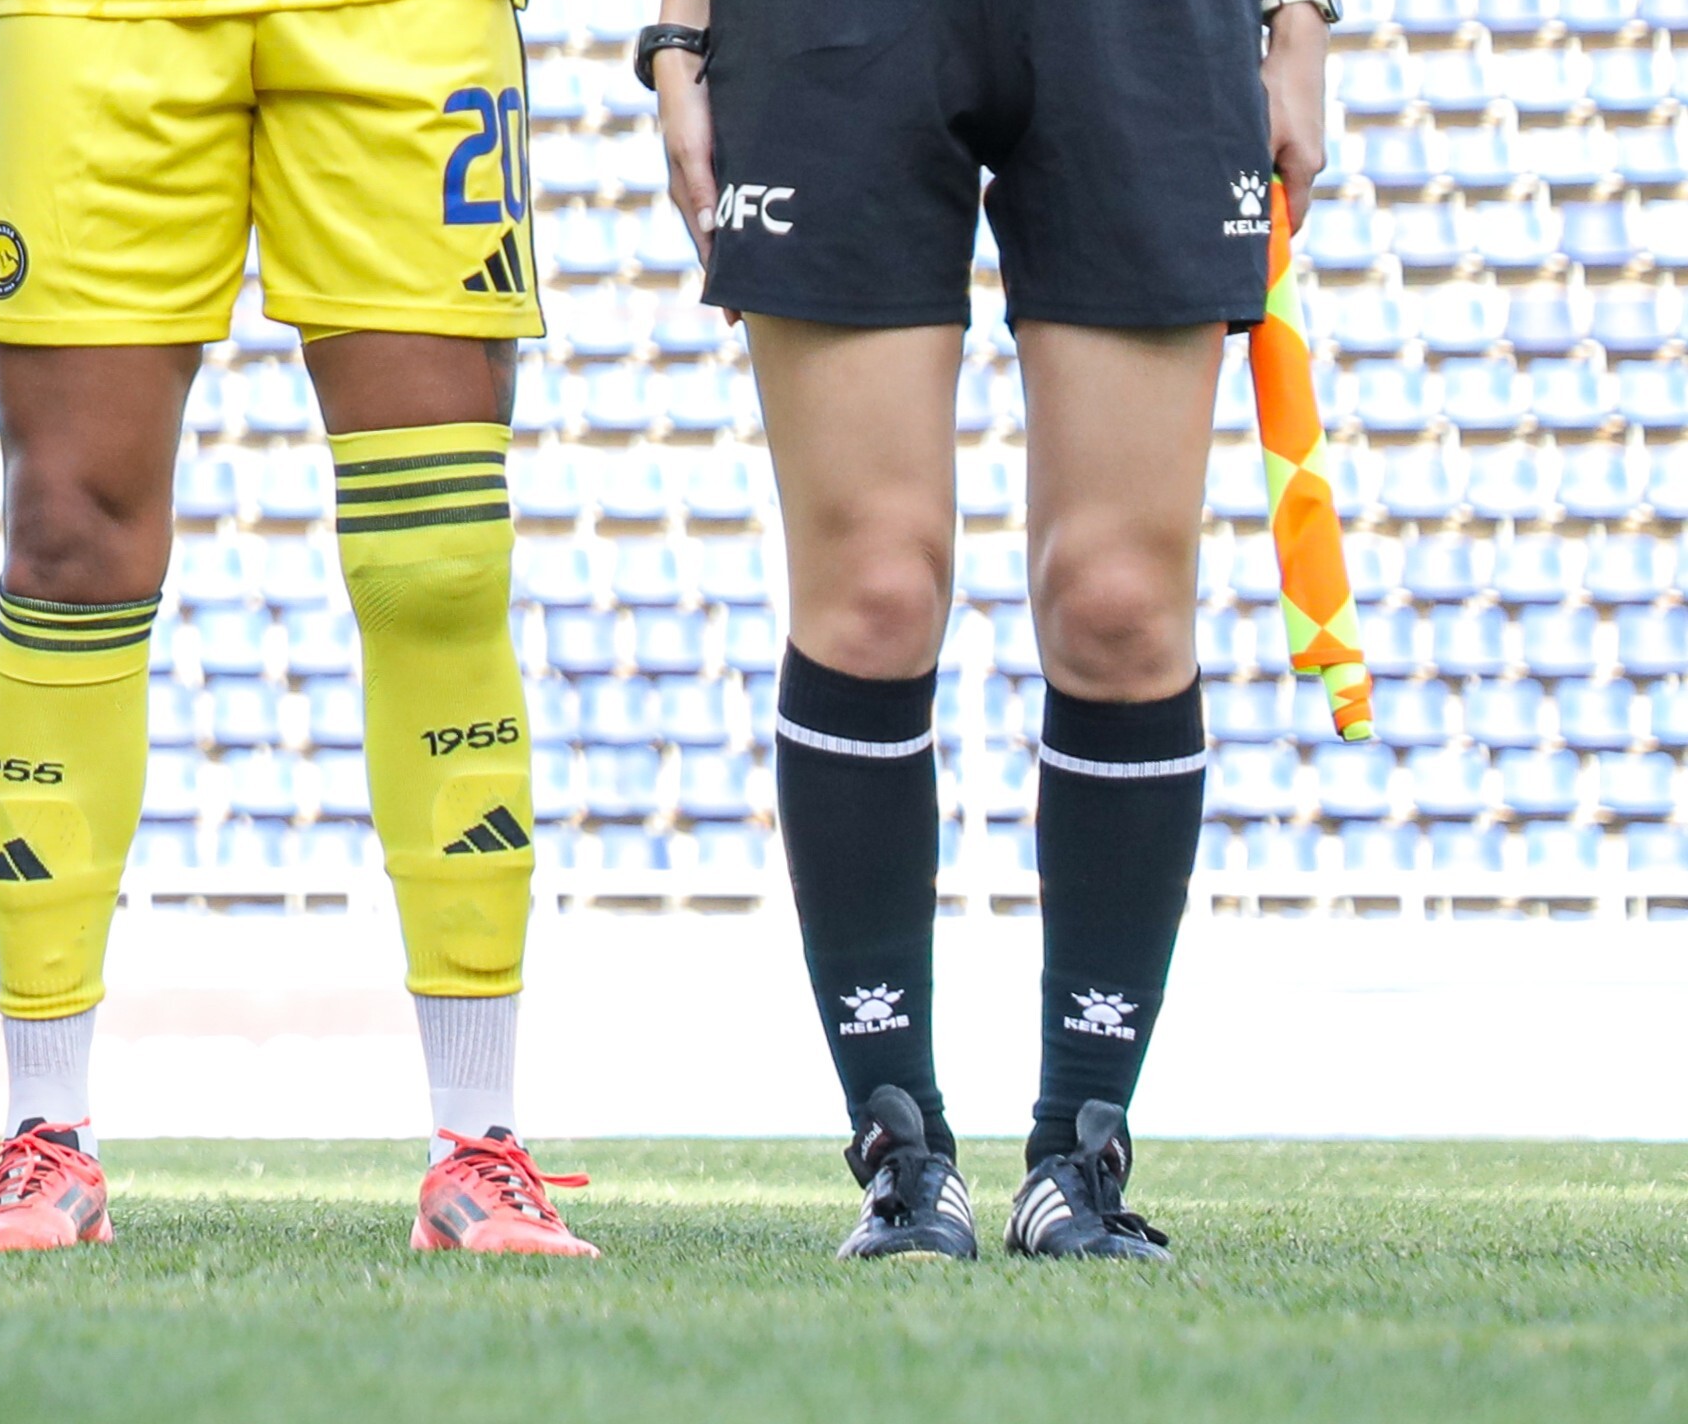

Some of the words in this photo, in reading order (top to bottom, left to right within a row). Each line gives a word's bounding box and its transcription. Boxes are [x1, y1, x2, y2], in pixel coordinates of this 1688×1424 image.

[443, 87, 527, 224] 20
[715, 183, 796, 235] AFC
[421, 717, 520, 756] 1955
[839, 1013, 910, 1035] KELME
[1063, 1015, 1136, 1041] KELME
